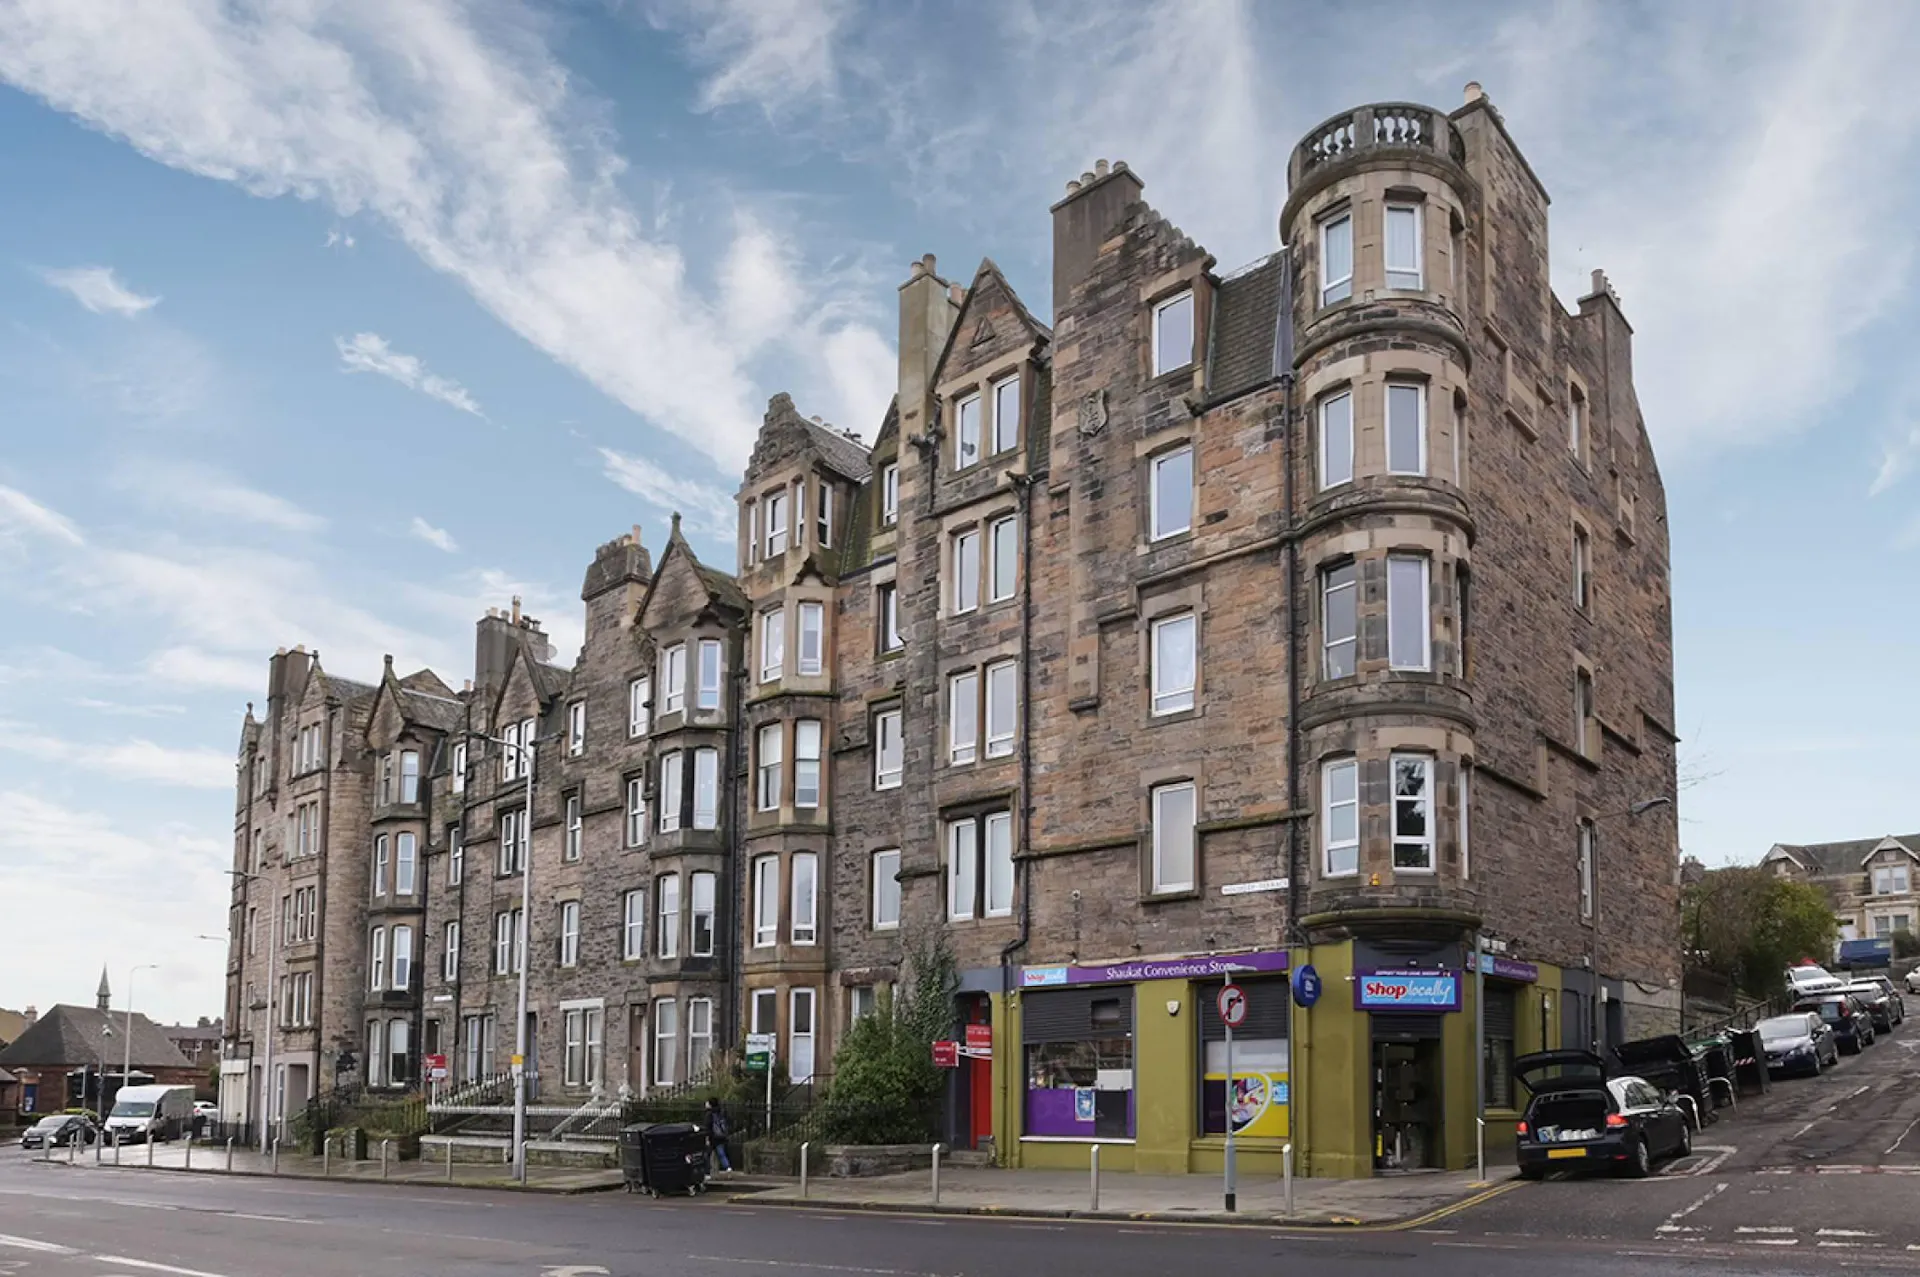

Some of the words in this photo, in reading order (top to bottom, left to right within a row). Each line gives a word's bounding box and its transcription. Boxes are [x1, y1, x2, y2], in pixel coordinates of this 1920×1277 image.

[1106, 966, 1143, 980] Shaukat
[1144, 961, 1207, 977] Convenience
[1366, 982, 1407, 999] Shop
[1408, 980, 1451, 1004] locally
